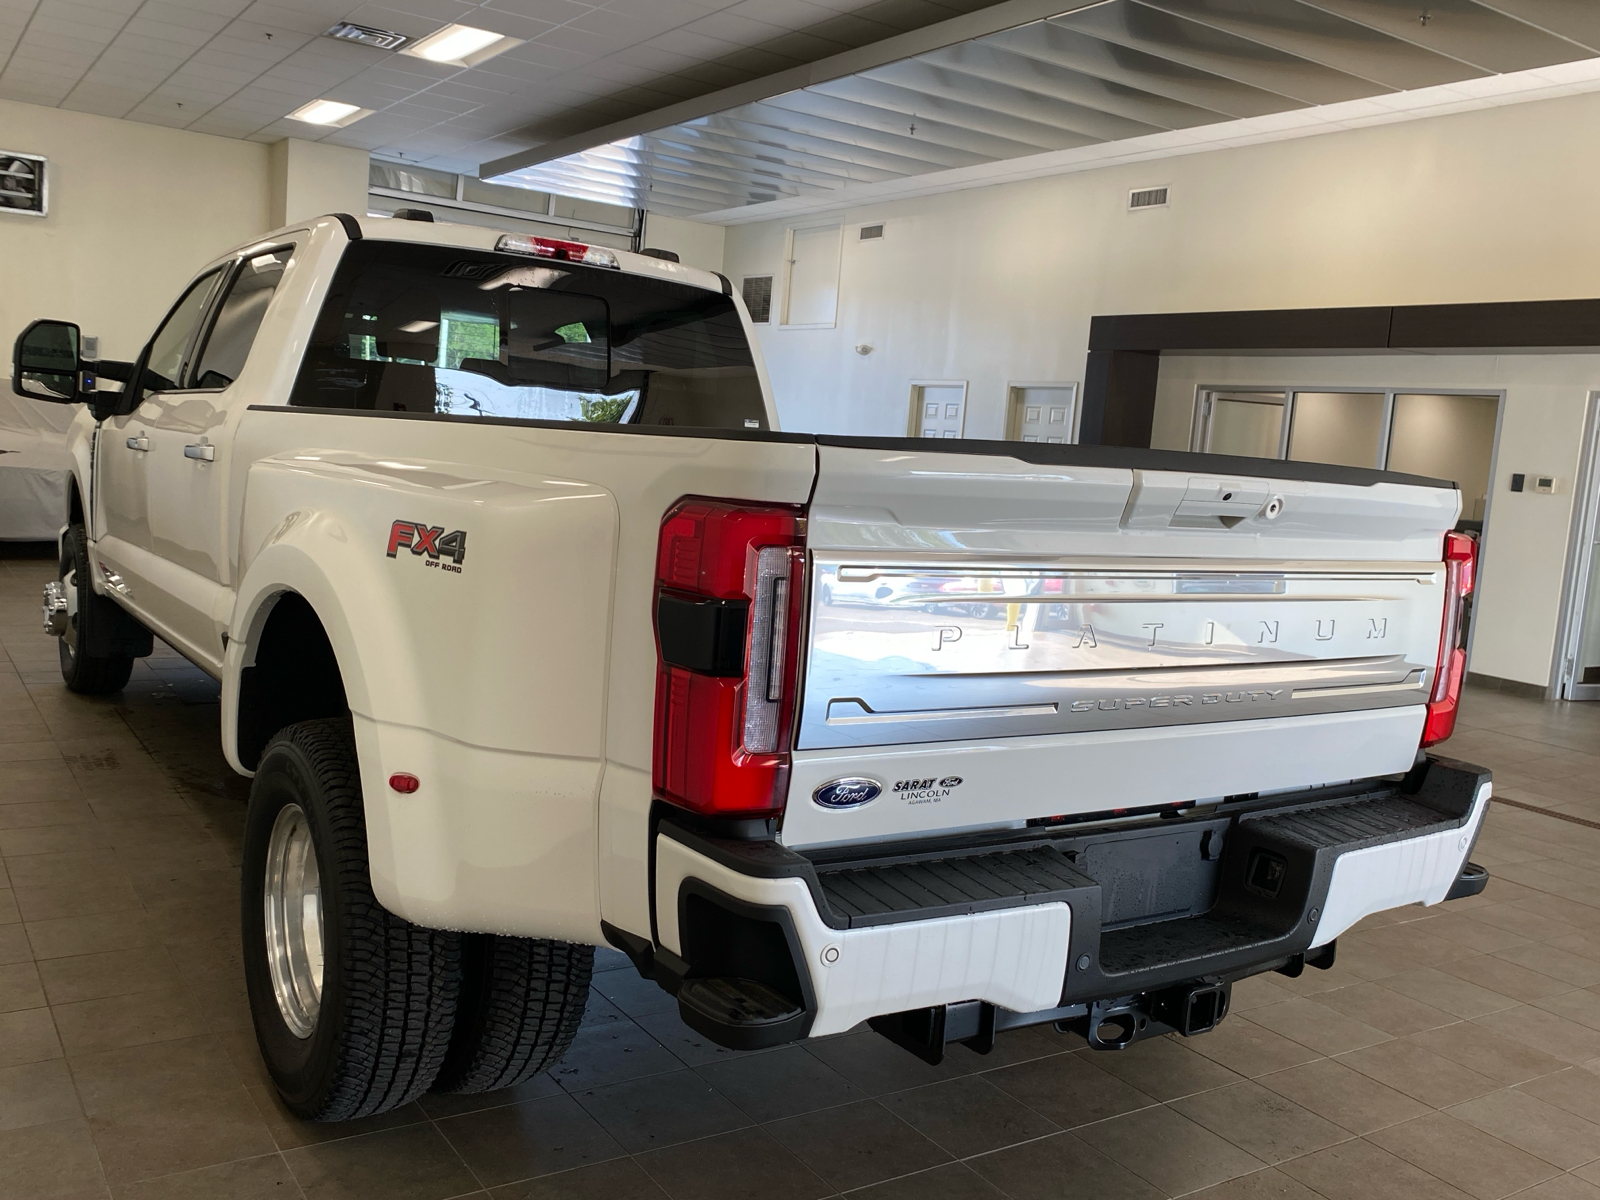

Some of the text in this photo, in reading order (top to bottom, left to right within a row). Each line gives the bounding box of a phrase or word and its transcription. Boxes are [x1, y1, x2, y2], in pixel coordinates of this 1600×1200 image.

[386, 519, 467, 565] FX4
[425, 559, 462, 574] OFF ROAD
[931, 617, 1388, 651] PLATINUM
[1070, 688, 1284, 713] SUPER DUTY
[830, 784, 869, 803] Ford
[892, 777, 938, 793] SARAT
[900, 789, 950, 800] LINCOLN
